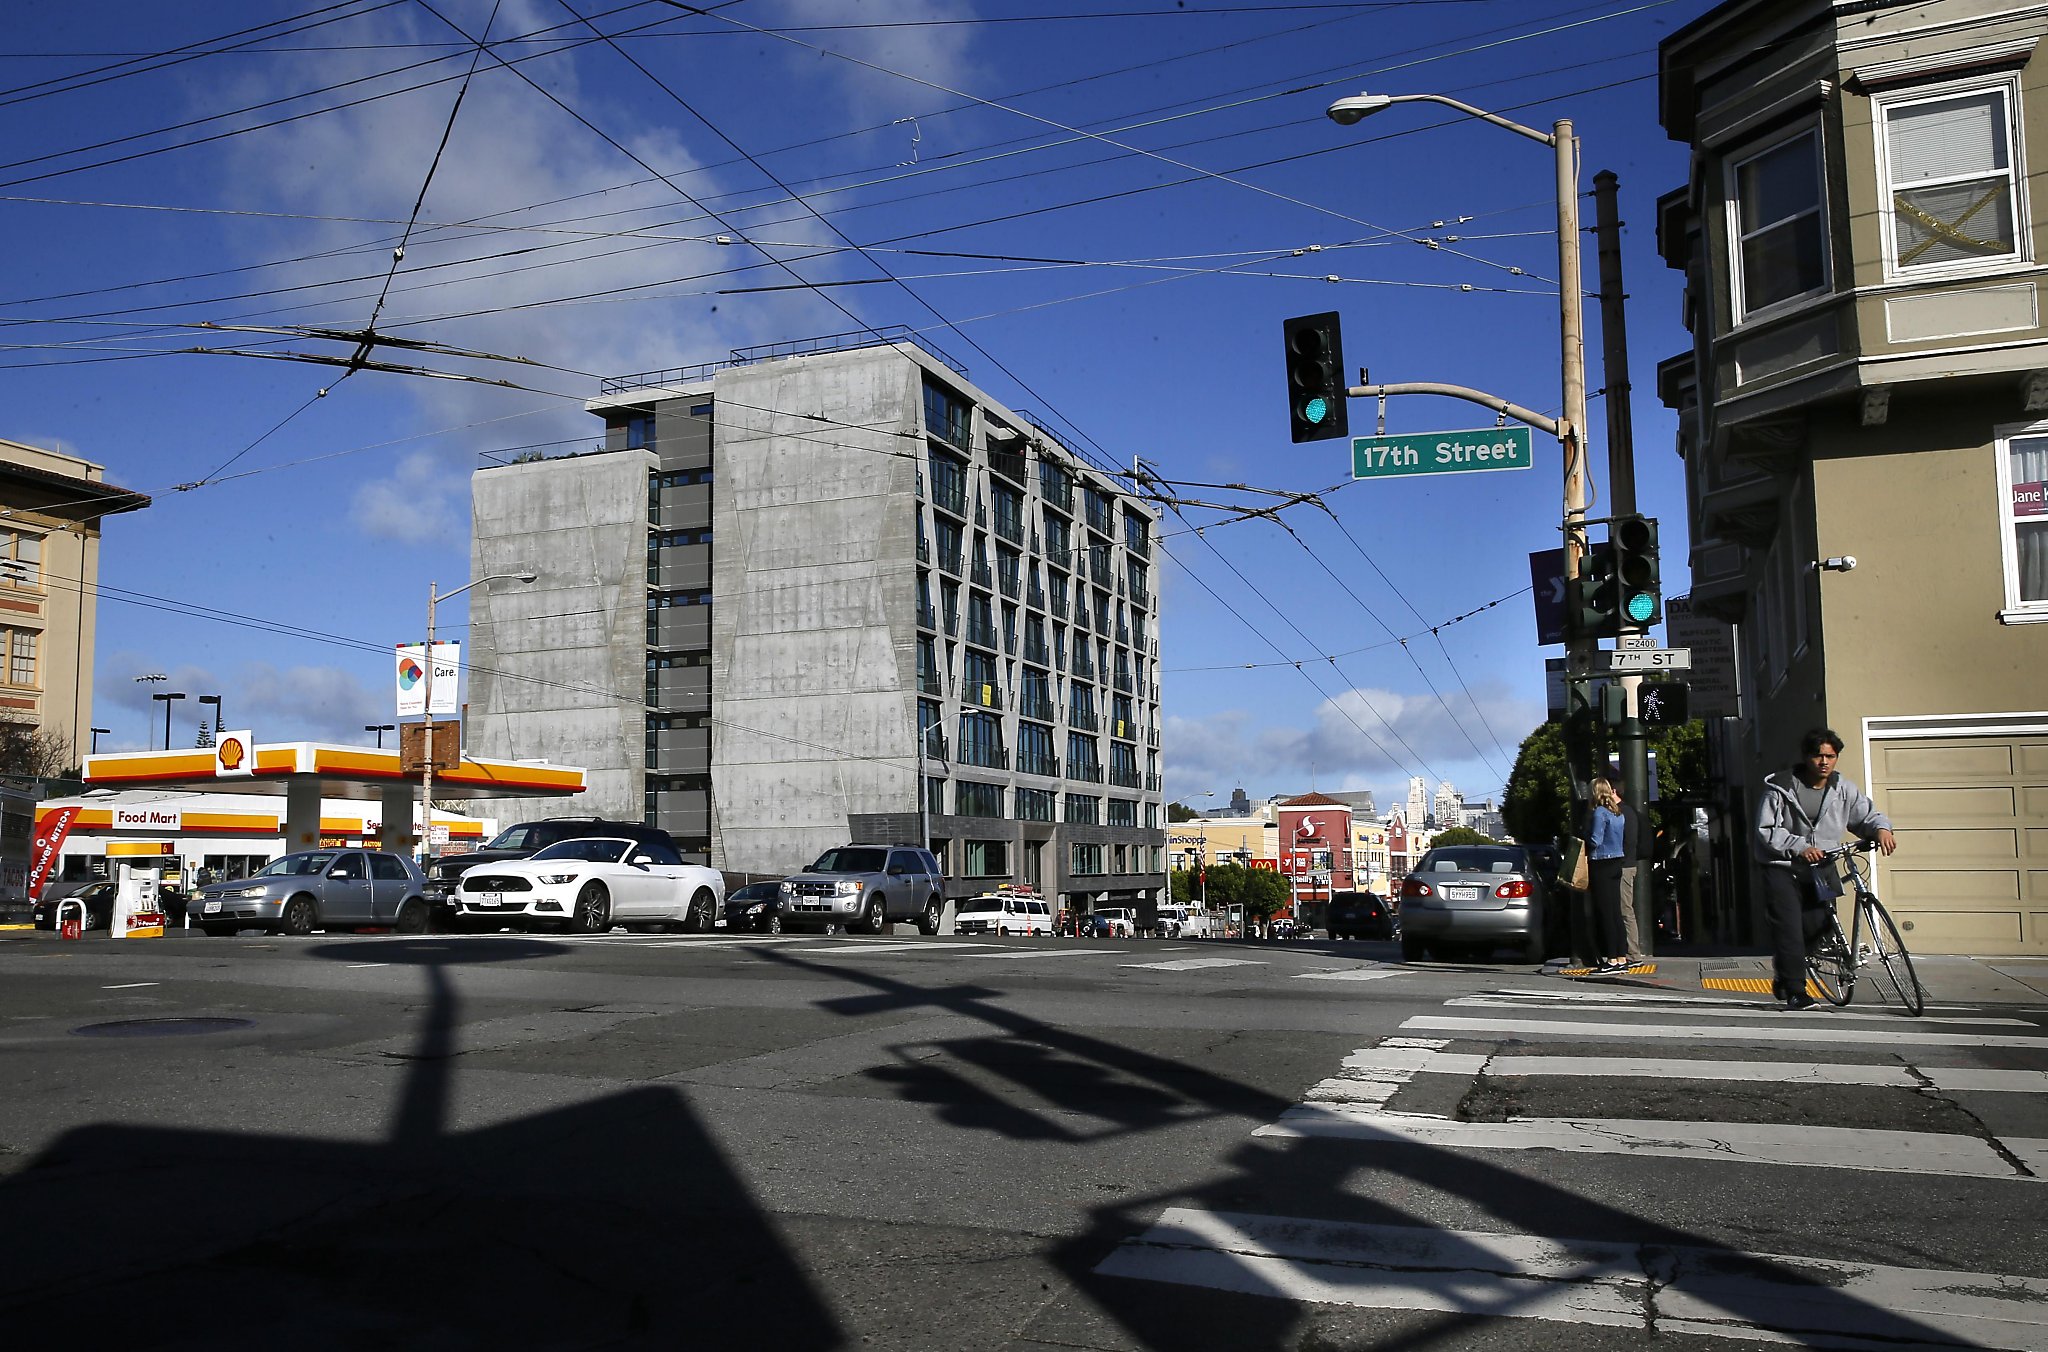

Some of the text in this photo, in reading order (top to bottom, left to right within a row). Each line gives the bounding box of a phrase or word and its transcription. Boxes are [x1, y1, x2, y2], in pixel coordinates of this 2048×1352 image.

[1364, 438, 1517, 468] 17th Street
[2013, 490, 2041, 503] Jane
[1635, 640, 1656, 648] 2400
[1615, 653, 1675, 666] 7TH ST
[434, 666, 457, 678] Care.
[118, 811, 177, 824] Food Mart
[366, 819, 383, 830] Ser
[163, 844, 168, 854] 6
[30, 844, 53, 889] V-Power
[1289, 875, 1313, 884] OReilly
